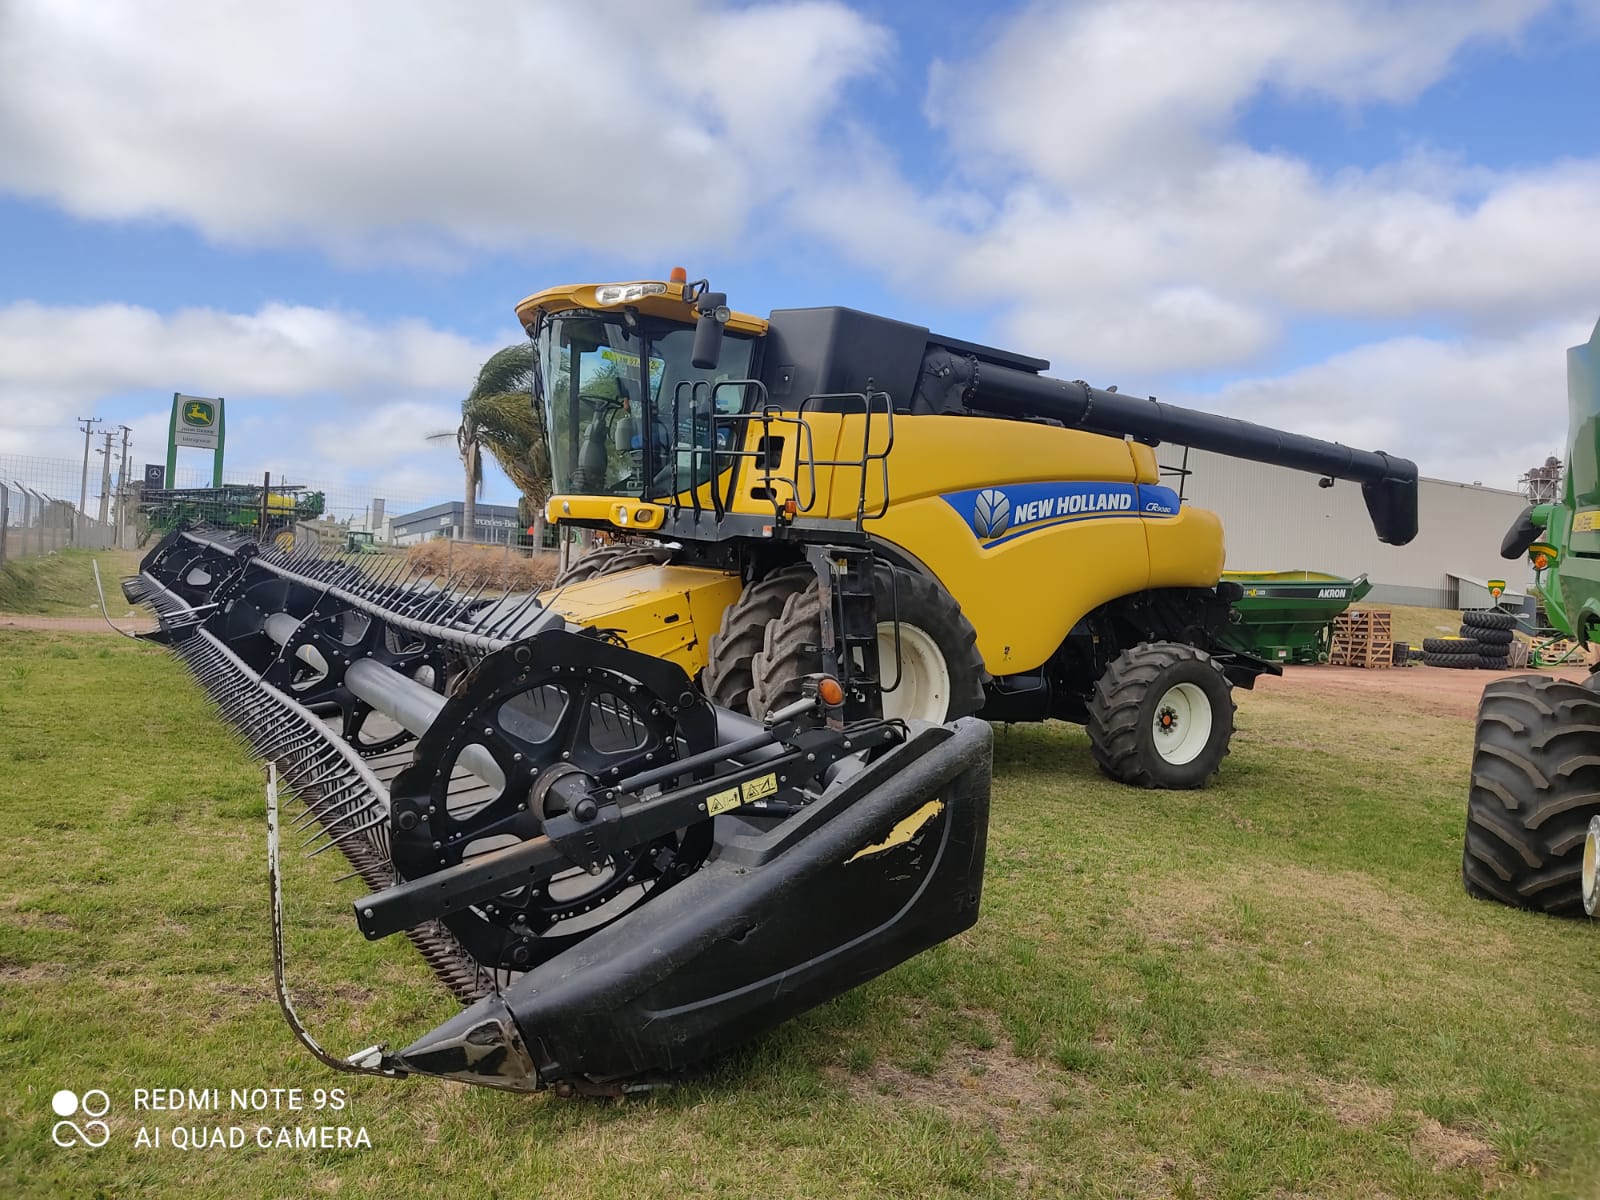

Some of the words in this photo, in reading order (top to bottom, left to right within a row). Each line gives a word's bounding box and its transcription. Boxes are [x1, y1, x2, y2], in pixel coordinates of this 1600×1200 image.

[1014, 499, 1053, 525] NEW
[1056, 493, 1132, 515] HOLLAND
[1318, 588, 1346, 598] AKRON
